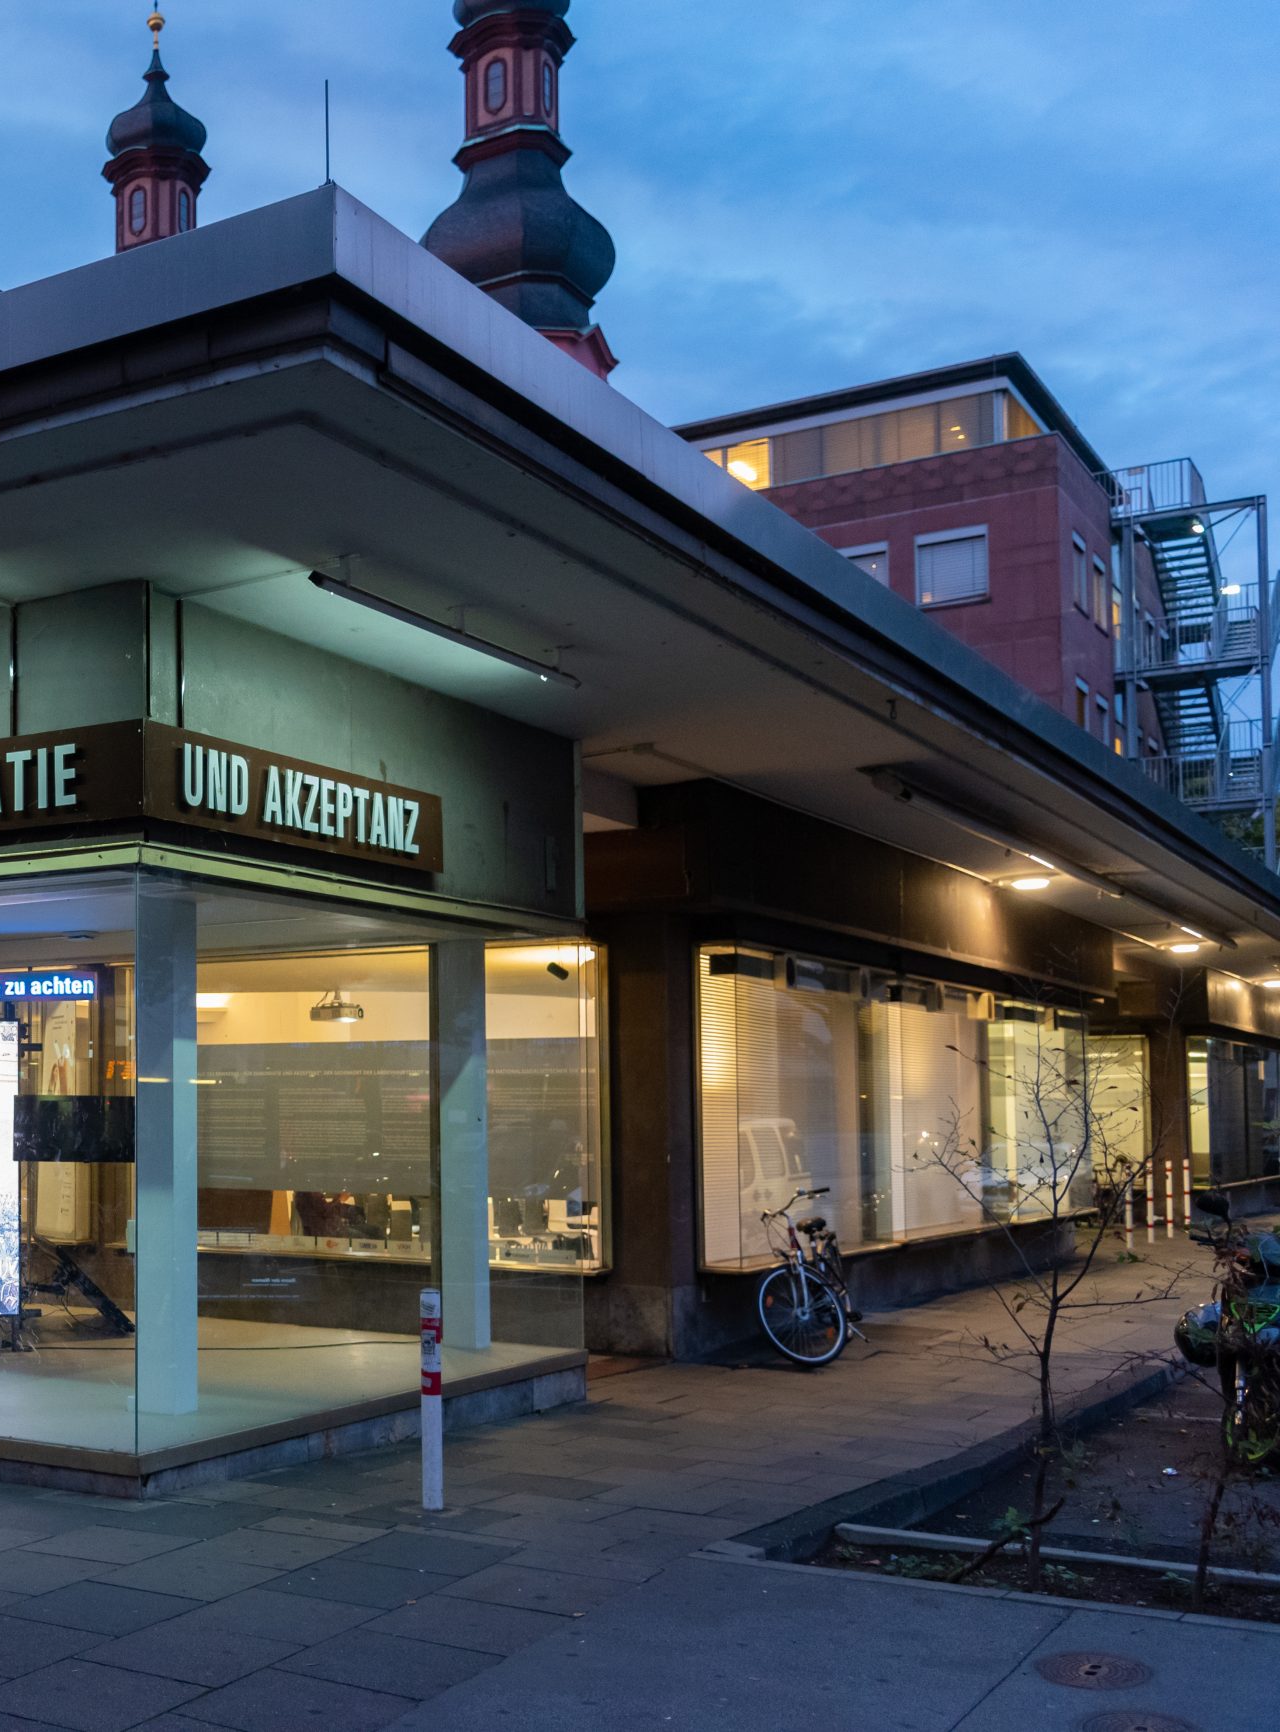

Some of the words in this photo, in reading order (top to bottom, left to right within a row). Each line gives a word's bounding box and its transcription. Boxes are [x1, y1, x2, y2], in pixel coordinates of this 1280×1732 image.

[182, 743, 250, 815] UND
[263, 768, 420, 855] AKZEPTANZ
[4, 980, 25, 996] zu
[30, 976, 94, 995] achten
